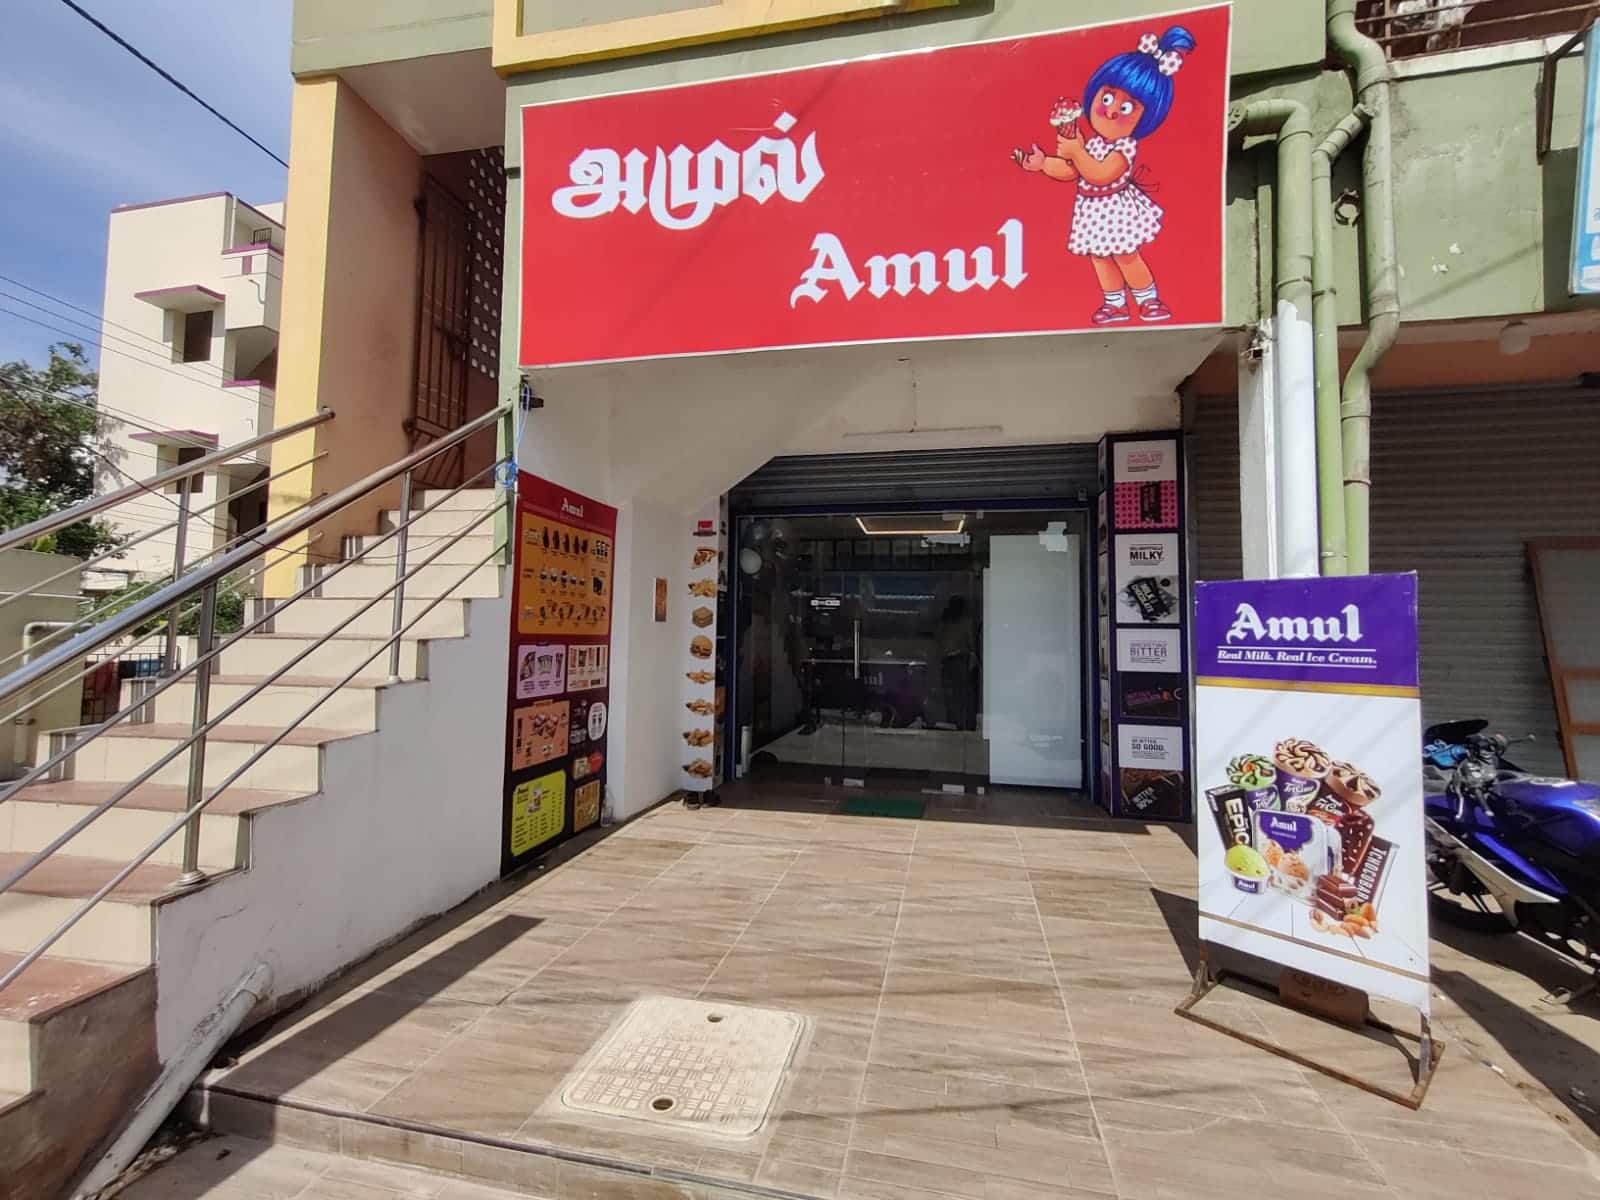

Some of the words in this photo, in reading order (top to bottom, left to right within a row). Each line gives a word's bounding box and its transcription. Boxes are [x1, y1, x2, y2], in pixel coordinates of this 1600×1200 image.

[551, 112, 826, 230] அமுல்
[790, 218, 1028, 309] Amul
[1226, 603, 1363, 645] Amul
[1130, 647, 1167, 656] BITTER
[1217, 650, 1243, 660] Real
[1244, 651, 1274, 661] Milk.
[1276, 651, 1304, 662] Real
[1306, 652, 1325, 663] Ice
[1328, 652, 1377, 664] Cream.
[1270, 817, 1297, 832] Amul
